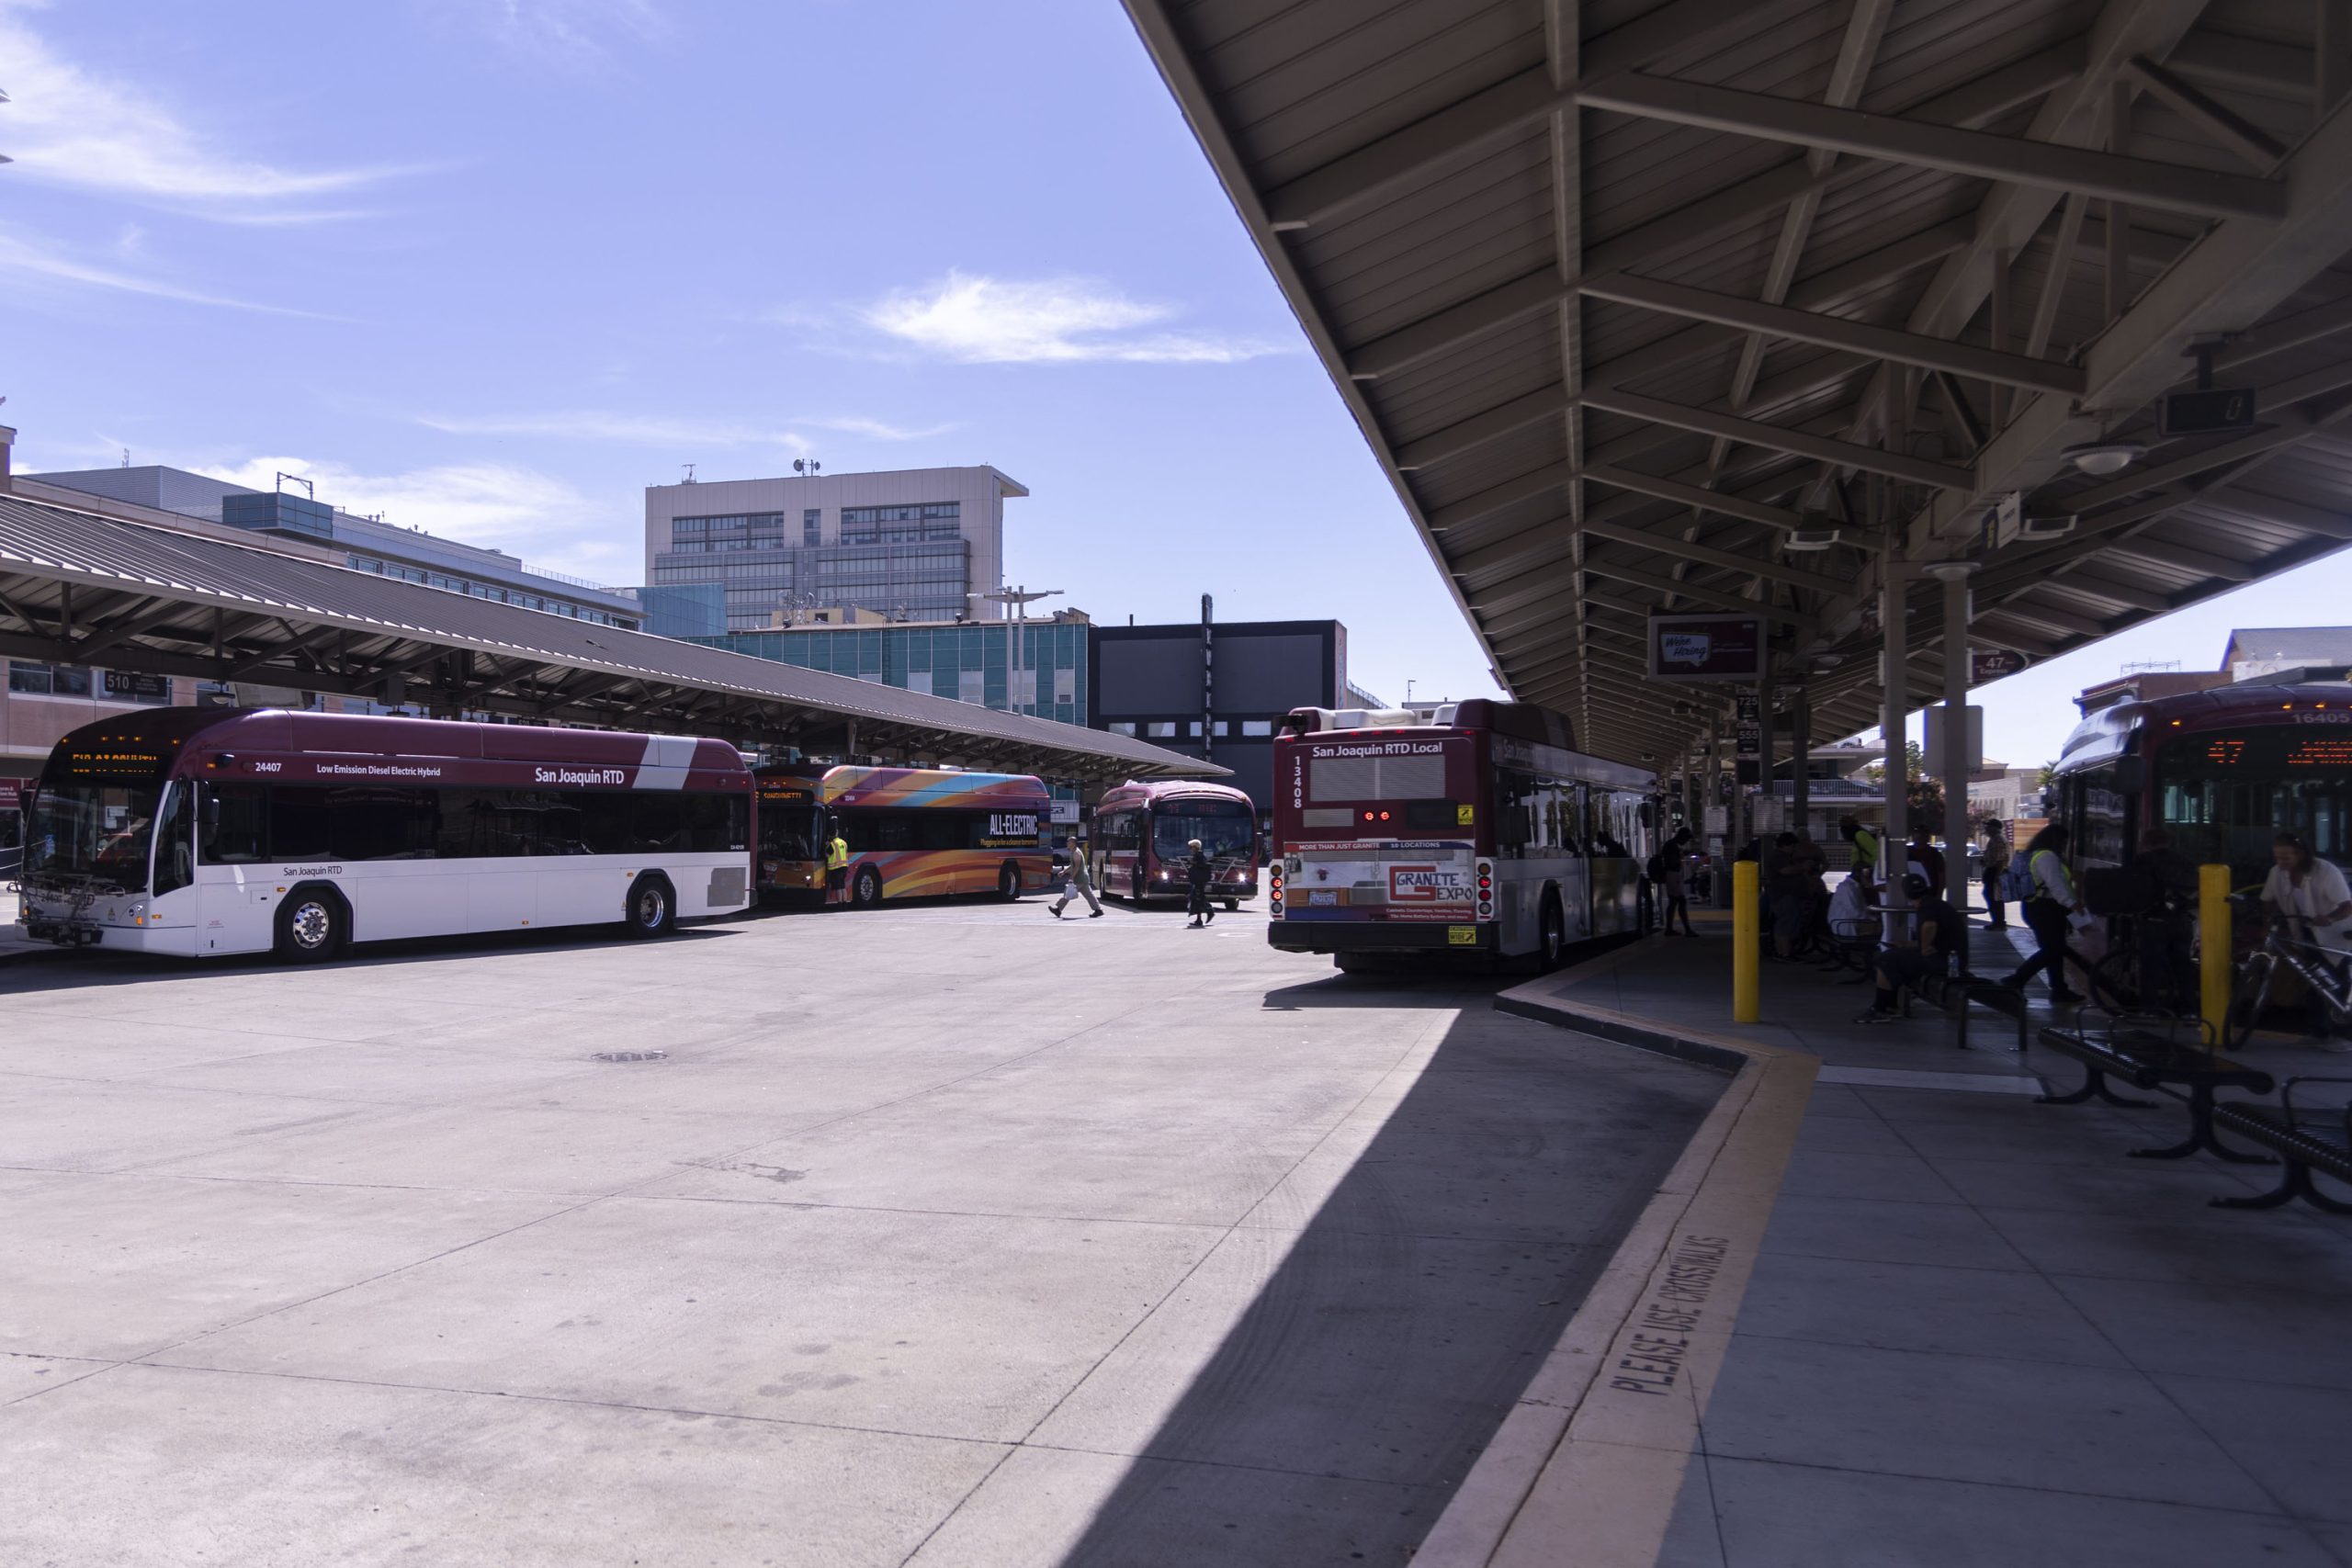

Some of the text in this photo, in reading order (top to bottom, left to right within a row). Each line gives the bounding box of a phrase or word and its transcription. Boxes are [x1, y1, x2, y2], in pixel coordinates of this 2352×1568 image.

[1985, 657, 2005, 669] 47
[107, 674, 130, 689] 510
[1738, 696, 1758, 706] 725
[2292, 713, 2351, 724] 16405
[1738, 730, 1758, 739] 555
[1313, 742, 1442, 759] San Joaquin RTD Local
[255, 762, 282, 772] 24407
[317, 764, 441, 777] Low Emission Diesel Electric Hybrid
[535, 767, 625, 786] San Joaquin RTD
[1294, 756, 1302, 809] 13408
[989, 814, 1037, 835] ALL-ELECTRIC
[283, 865, 343, 877] San Joaquin RTD
[1396, 873, 1460, 886] GRANITE
[1437, 887, 1474, 900] EXPO
[1610, 1235, 1730, 1396] PLEASE USE CROSSWALKS
